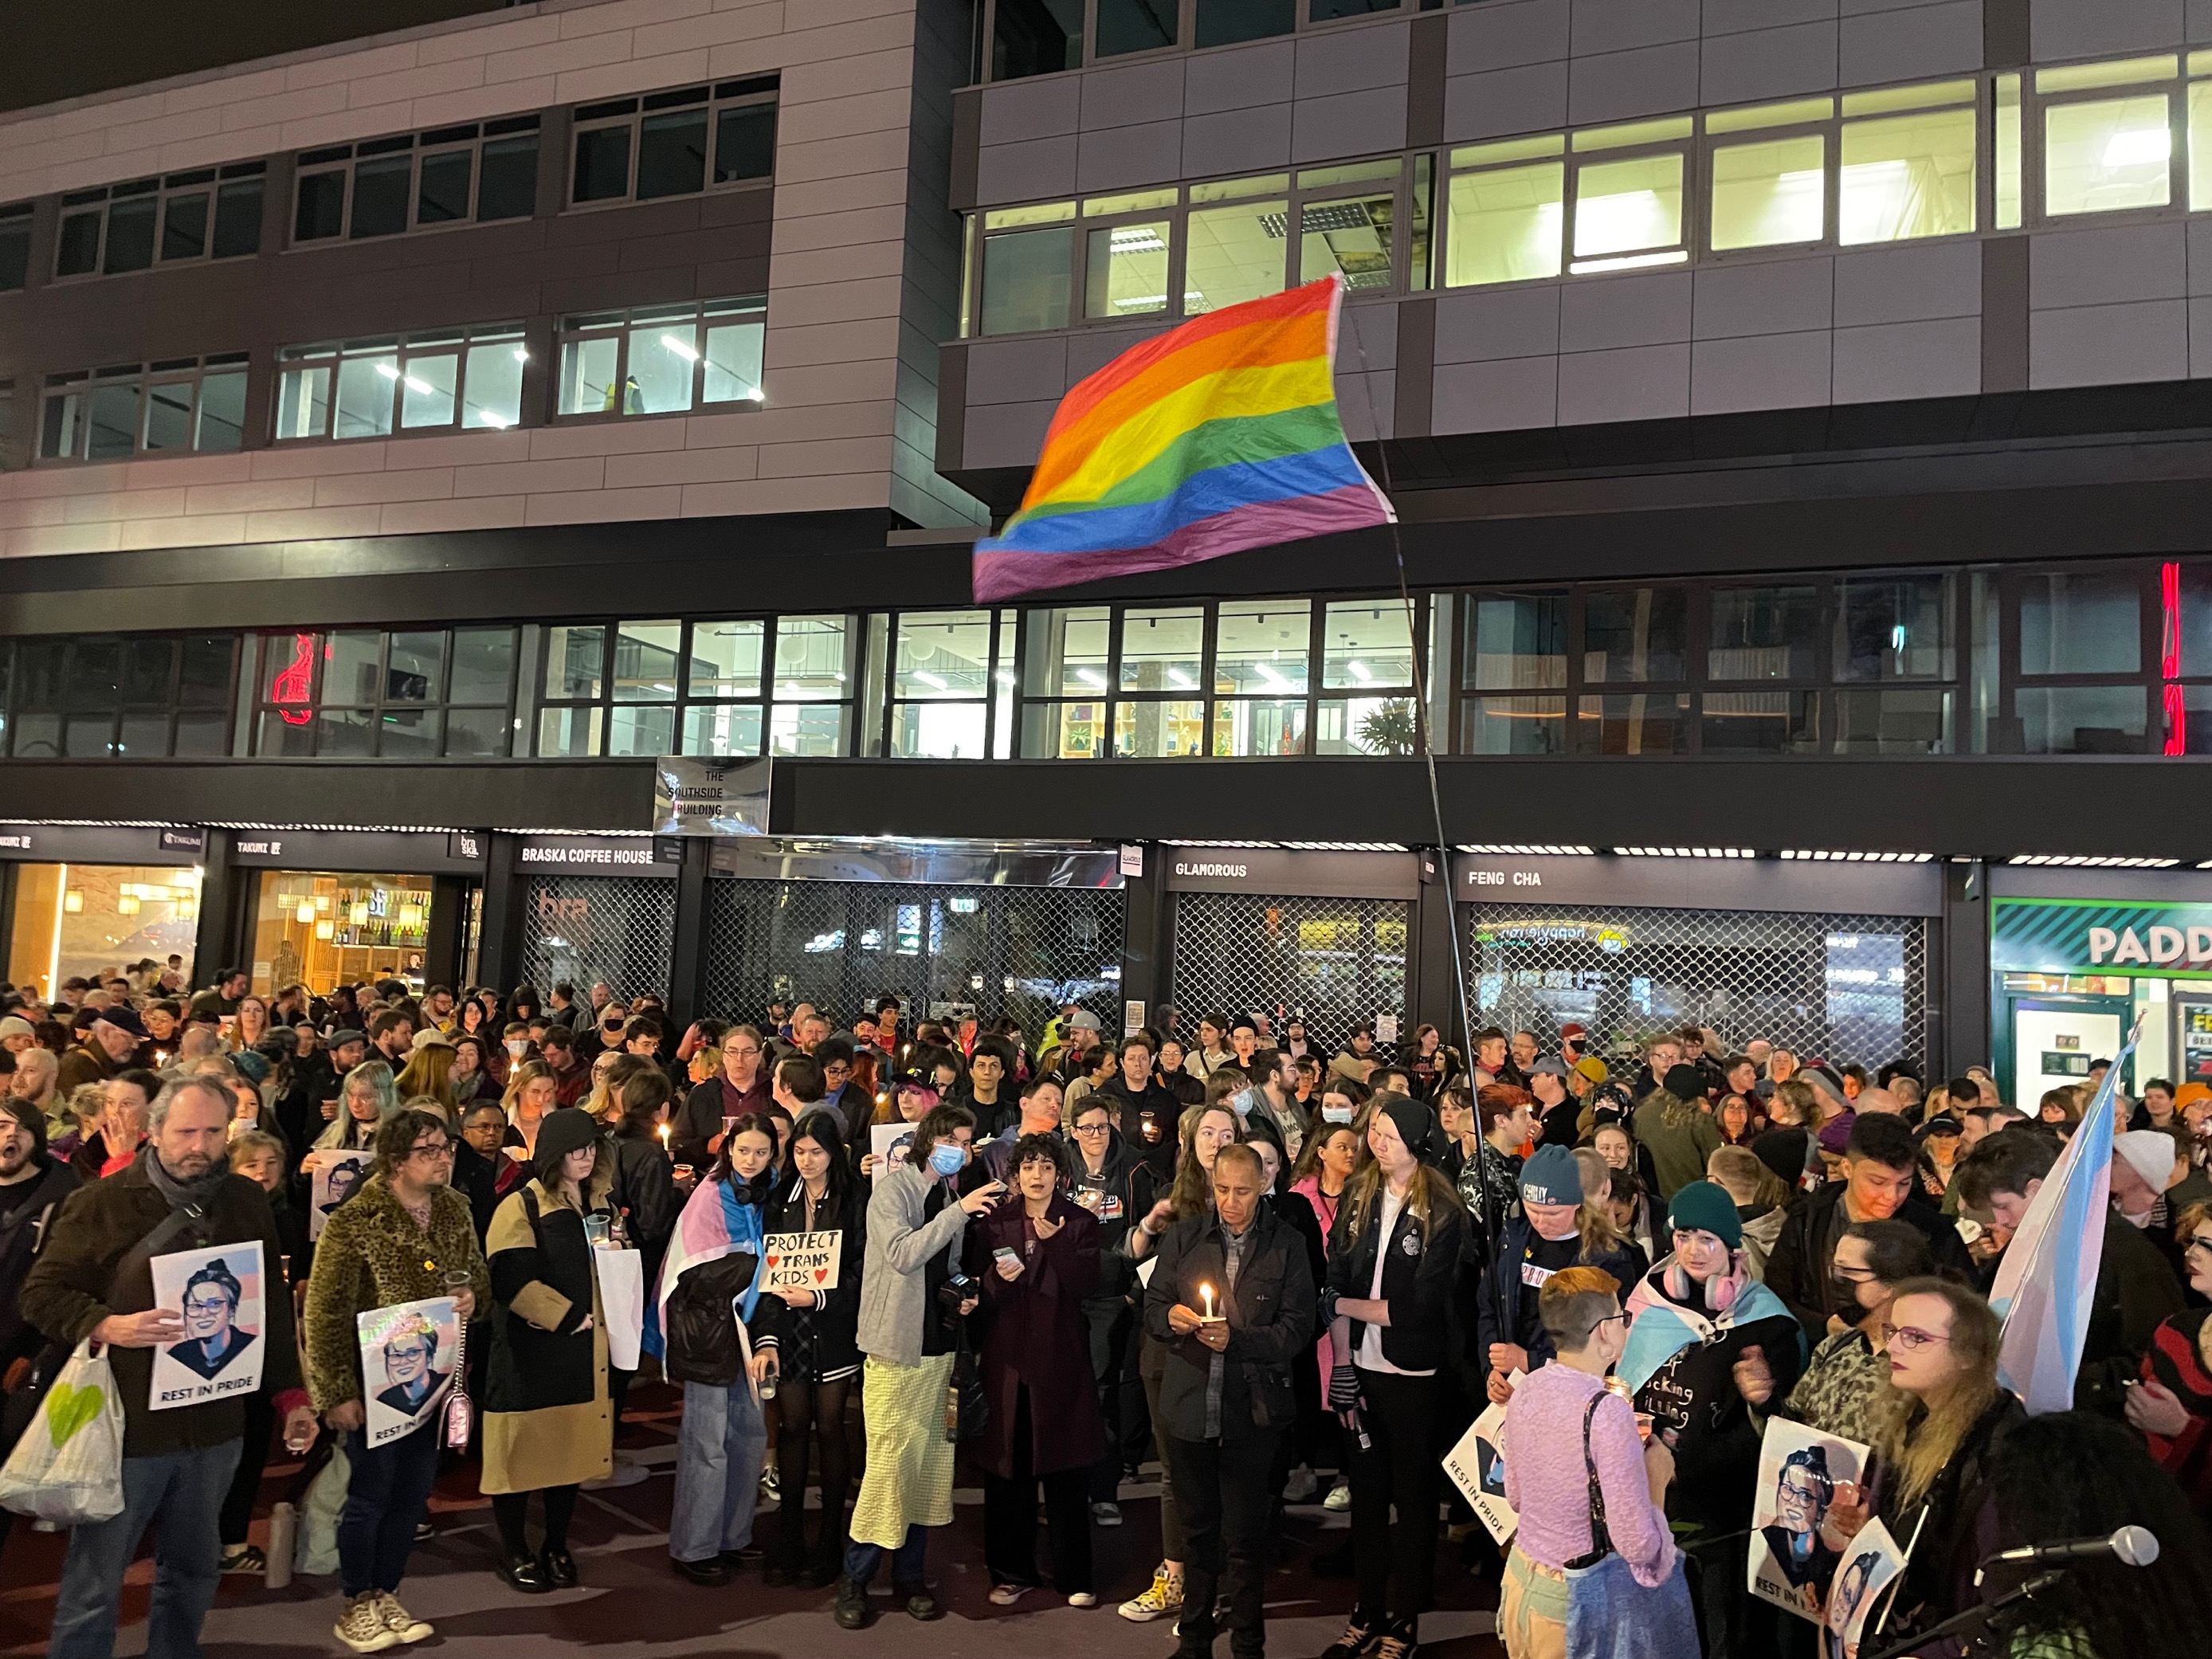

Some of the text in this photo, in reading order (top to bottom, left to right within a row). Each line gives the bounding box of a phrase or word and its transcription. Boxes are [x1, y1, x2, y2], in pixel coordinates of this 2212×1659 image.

[705, 771, 724, 782] THE
[668, 787, 723, 798] SOUTHSIDE
[522, 848, 567, 862] BRASKA
[568, 849, 612, 863] COFFEE
[614, 849, 653, 865] HOUSE
[1175, 863, 1247, 877] GLAMOROUS
[1469, 871, 1542, 886] FENG CHA
[765, 1232, 839, 1253] PROTECT
[782, 1253, 830, 1268] TRANS
[771, 1270, 809, 1286] KIDS
[161, 1376, 253, 1402] REST IN PRIDE
[375, 1426, 401, 1441] REST
[1449, 1460, 1504, 1534] REST IN PRIDE
[1755, 1576, 1798, 1606] REST IN
